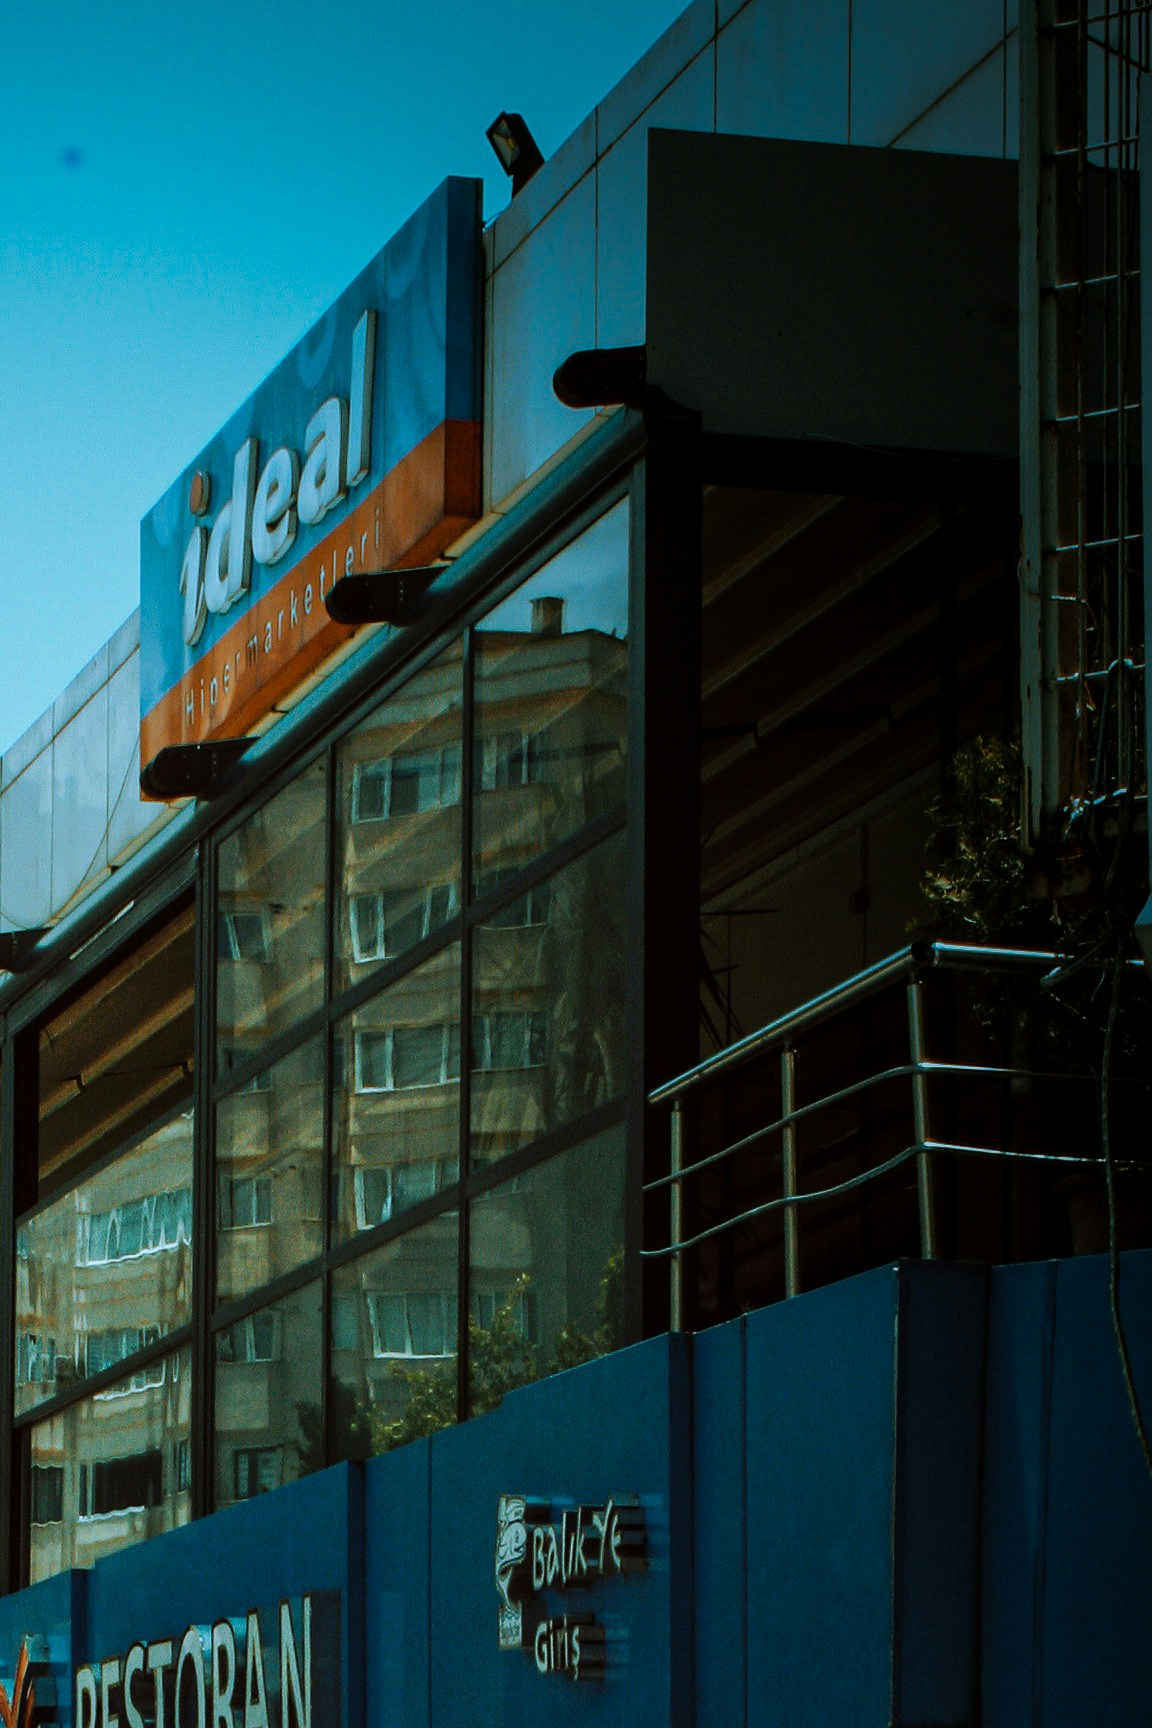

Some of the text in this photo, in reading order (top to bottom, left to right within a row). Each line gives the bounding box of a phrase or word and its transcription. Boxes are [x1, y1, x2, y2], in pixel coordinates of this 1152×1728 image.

[180, 309, 377, 646] ideal
[186, 507, 379, 724] Hipermarketleri
[535, 1614, 581, 1680] Giriş
